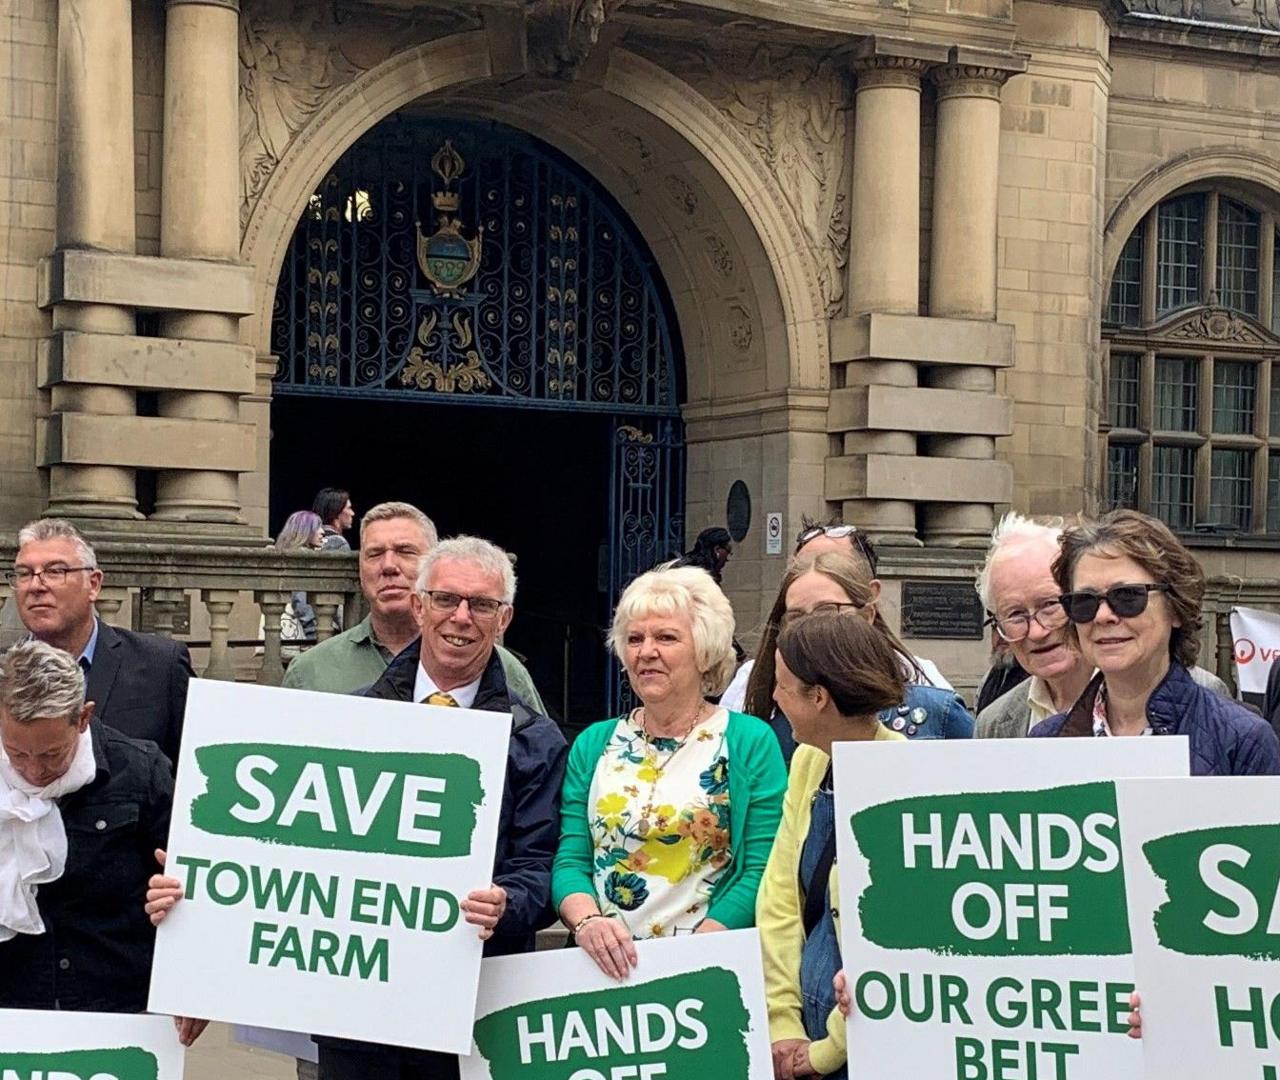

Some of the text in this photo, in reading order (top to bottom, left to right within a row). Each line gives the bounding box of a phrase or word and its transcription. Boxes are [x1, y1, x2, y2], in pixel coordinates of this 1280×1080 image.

[228, 754, 447, 846] SAVE
[901, 812, 1119, 873] HANDS
[175, 855, 460, 933] TOWN END
[951, 881, 1069, 942] OFF
[248, 922, 389, 983] FARM
[517, 998, 709, 1064] HANDS
[855, 971, 1136, 1034] OUR GREE
